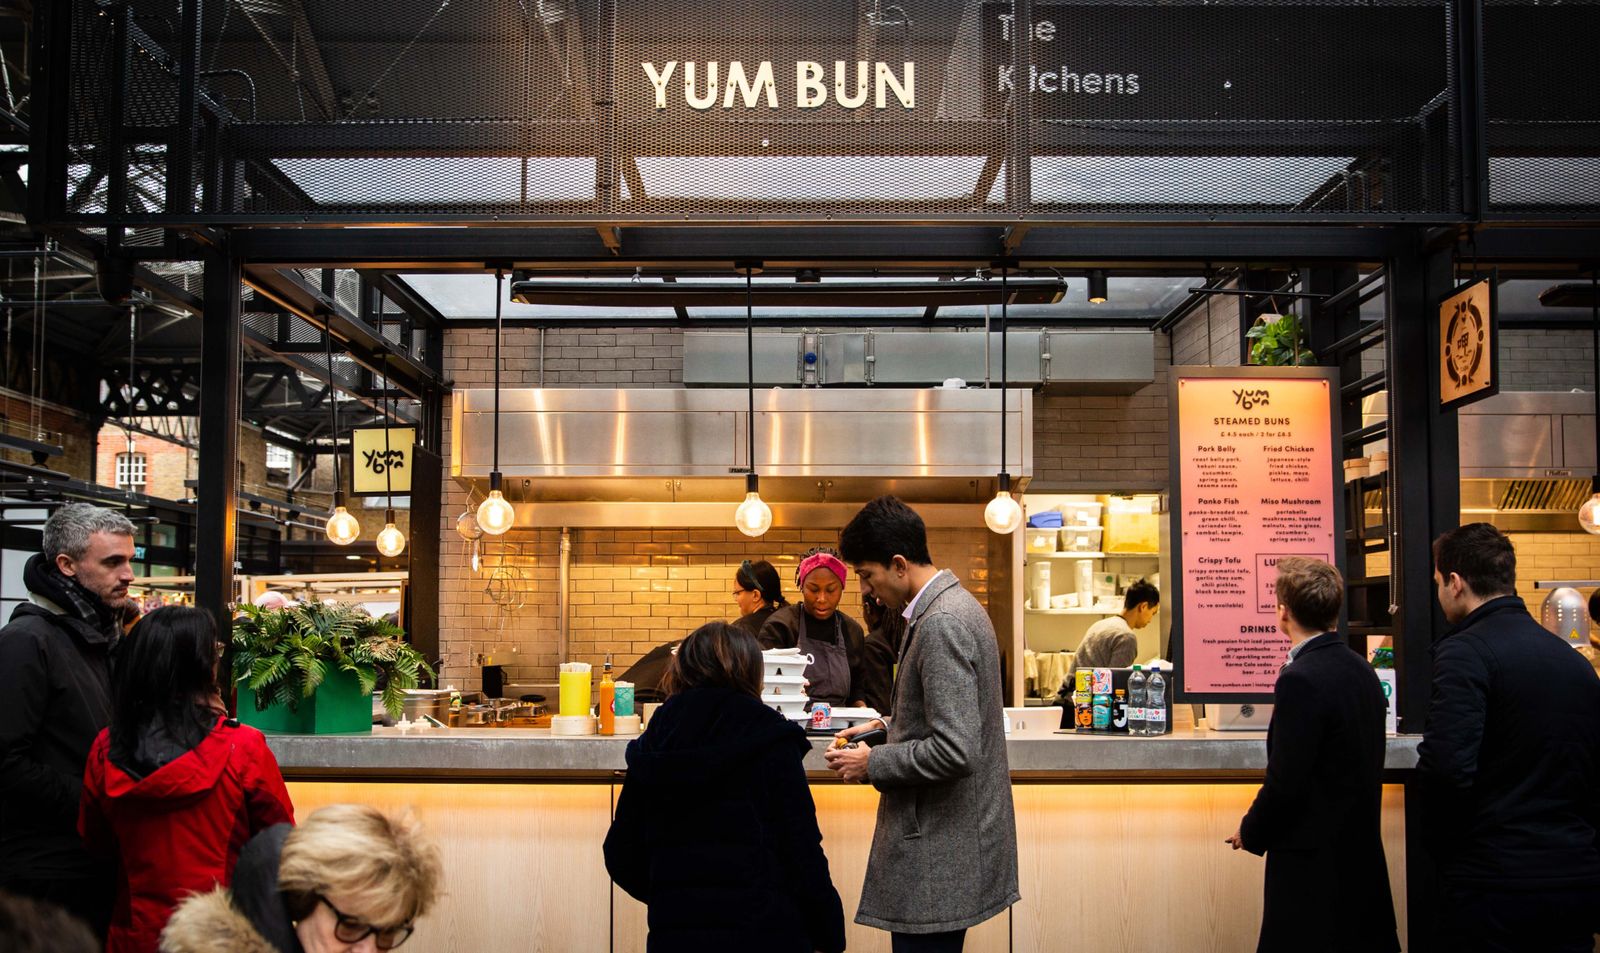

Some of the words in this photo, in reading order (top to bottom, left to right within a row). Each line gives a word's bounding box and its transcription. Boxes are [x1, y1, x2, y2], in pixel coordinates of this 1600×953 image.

[998, 65, 1140, 94] Ktchens
[641, 60, 779, 109] YUM
[797, 60, 915, 109] BUN
[1214, 417, 1261, 425] STEAMED
[1264, 417, 1290, 425] BUNS
[1217, 445, 1236, 453] Belly
[1198, 497, 1222, 505] Panko
[1223, 497, 1240, 505] Fish
[1198, 556, 1223, 565] Crispy
[1225, 556, 1242, 564] Tofu
[1240, 625, 1277, 634] DRINKS
